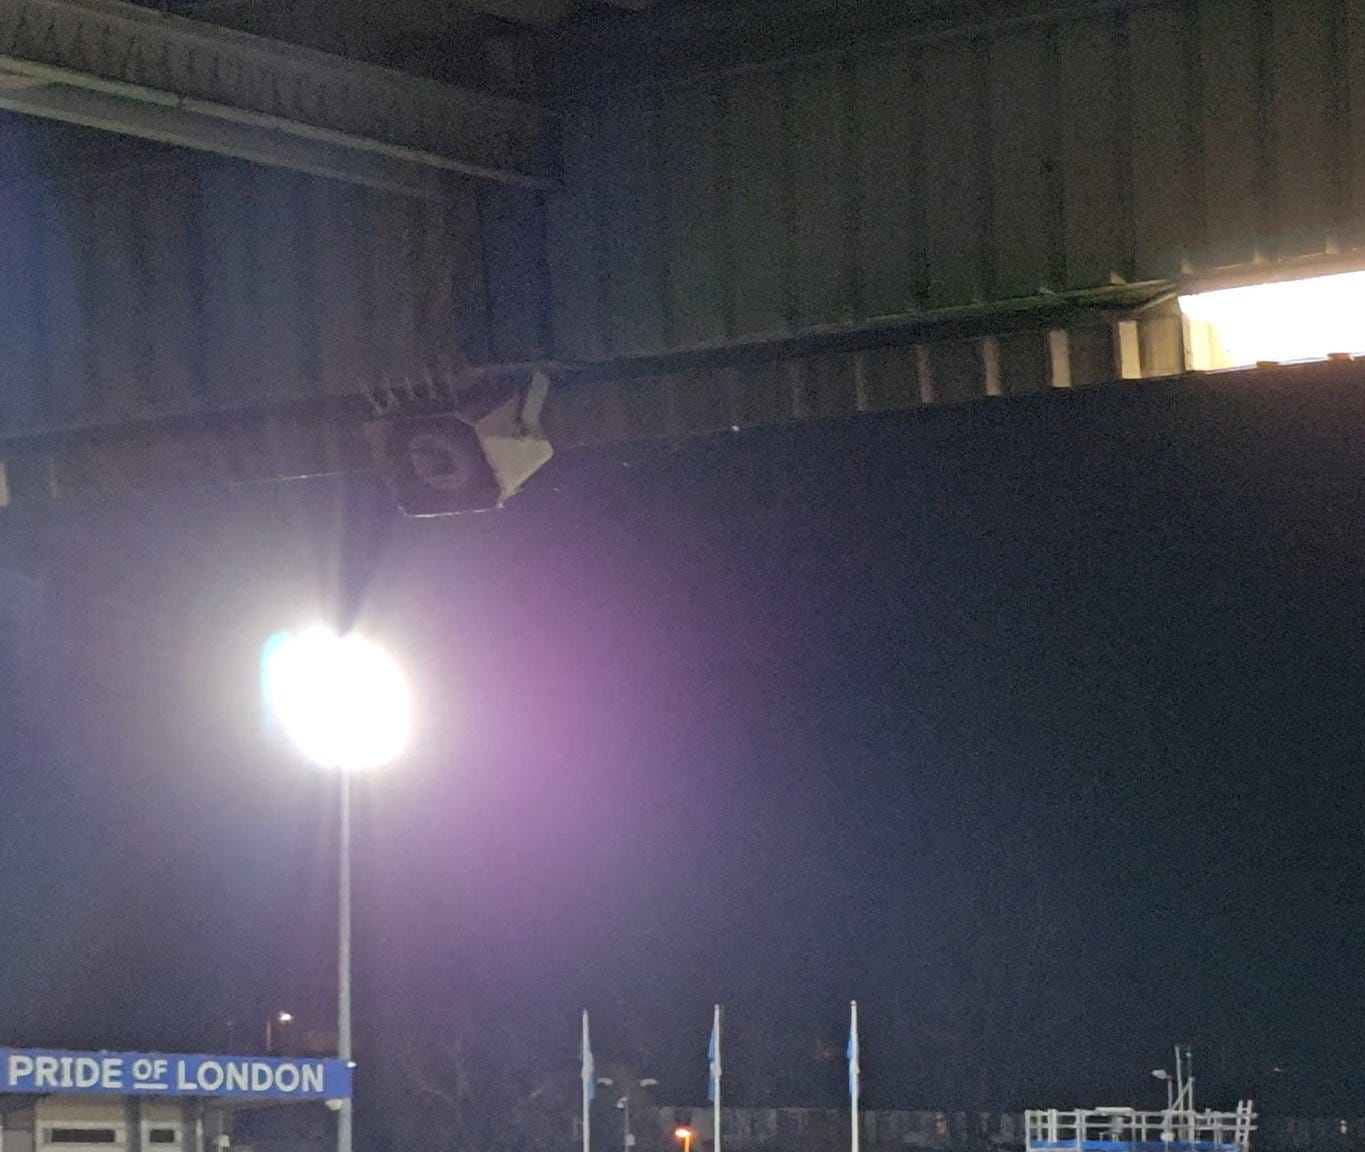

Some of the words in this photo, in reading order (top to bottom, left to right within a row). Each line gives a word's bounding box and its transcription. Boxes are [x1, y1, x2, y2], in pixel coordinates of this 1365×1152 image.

[8, 1055, 123, 1088] PRIDE
[132, 1059, 168, 1081] OF
[177, 1060, 324, 1093] LONDON
